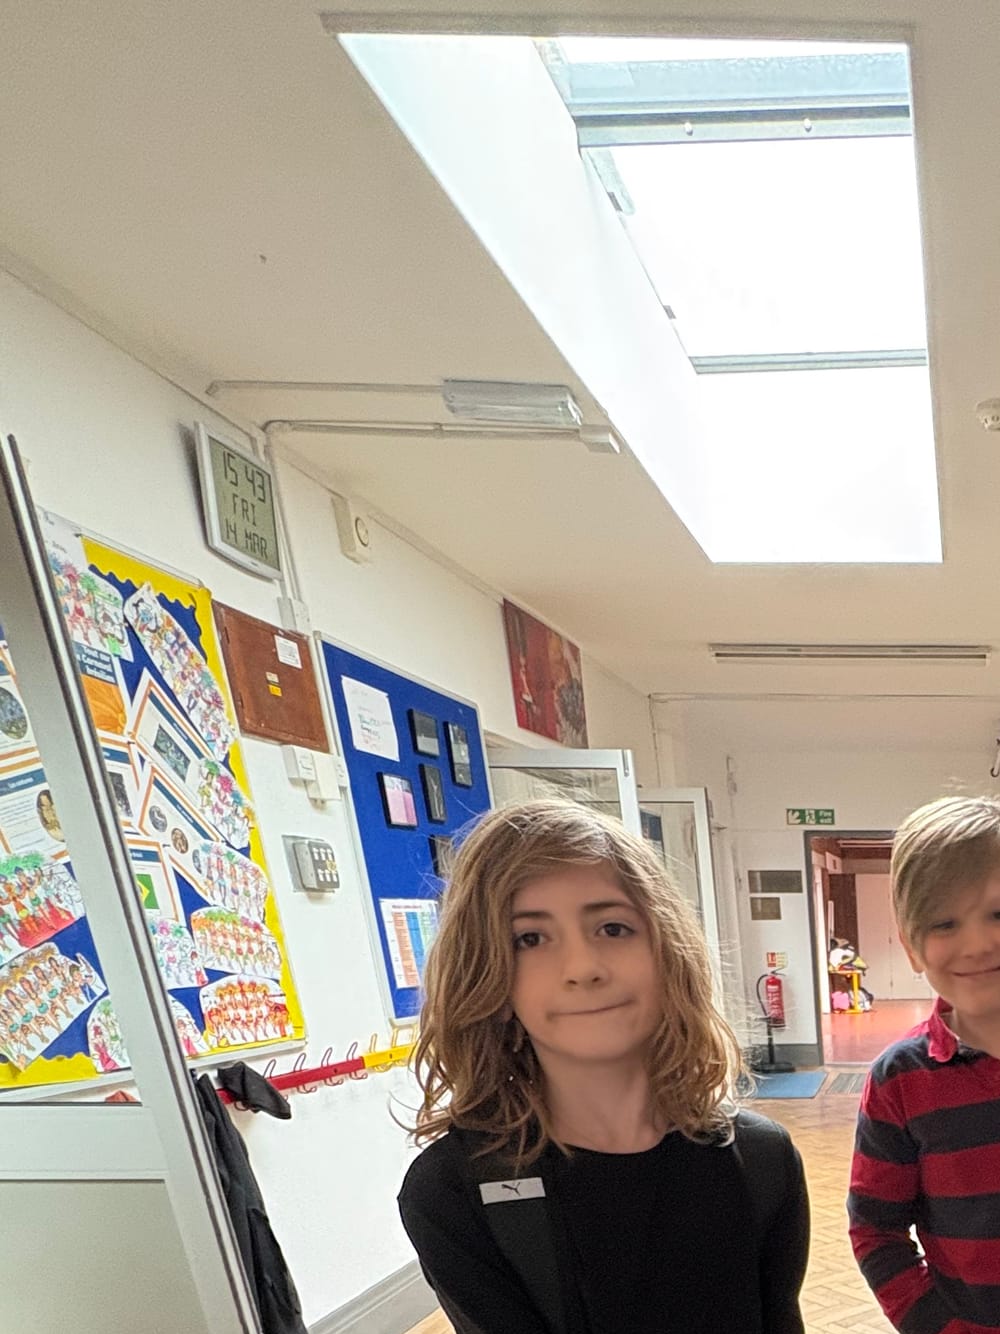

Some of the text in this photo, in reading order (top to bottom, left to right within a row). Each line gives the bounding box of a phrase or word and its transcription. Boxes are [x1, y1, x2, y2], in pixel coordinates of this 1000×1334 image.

[232, 492, 257, 527] FRI
[225, 518, 268, 559] 14 MAR
